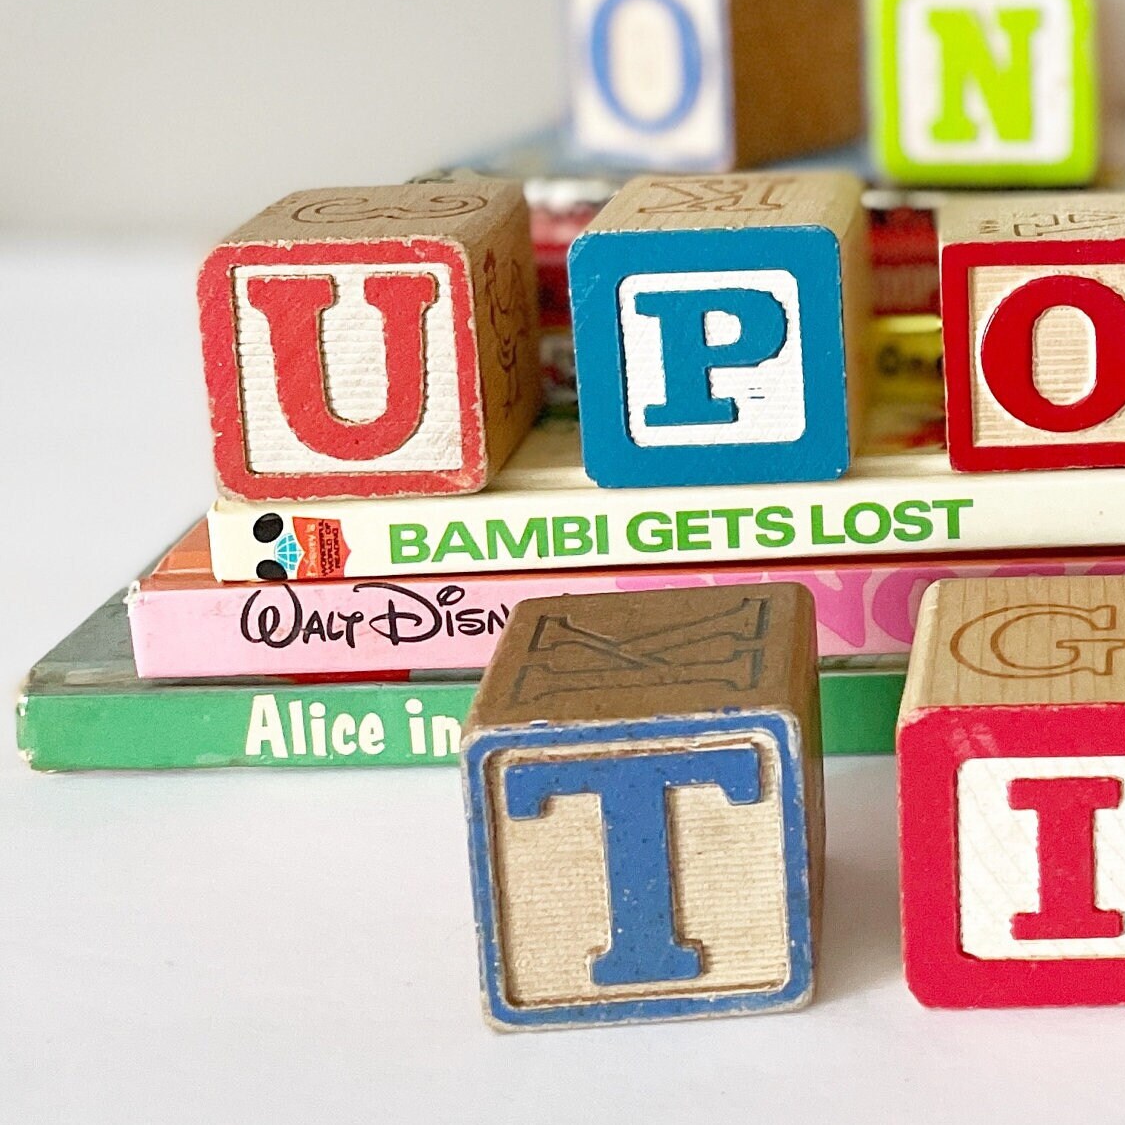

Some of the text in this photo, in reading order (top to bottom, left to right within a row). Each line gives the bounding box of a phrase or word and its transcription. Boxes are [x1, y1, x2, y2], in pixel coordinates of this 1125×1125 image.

[389, 498, 974, 565] BAMBI GETS LOST
[244, 693, 463, 759] Alice in
